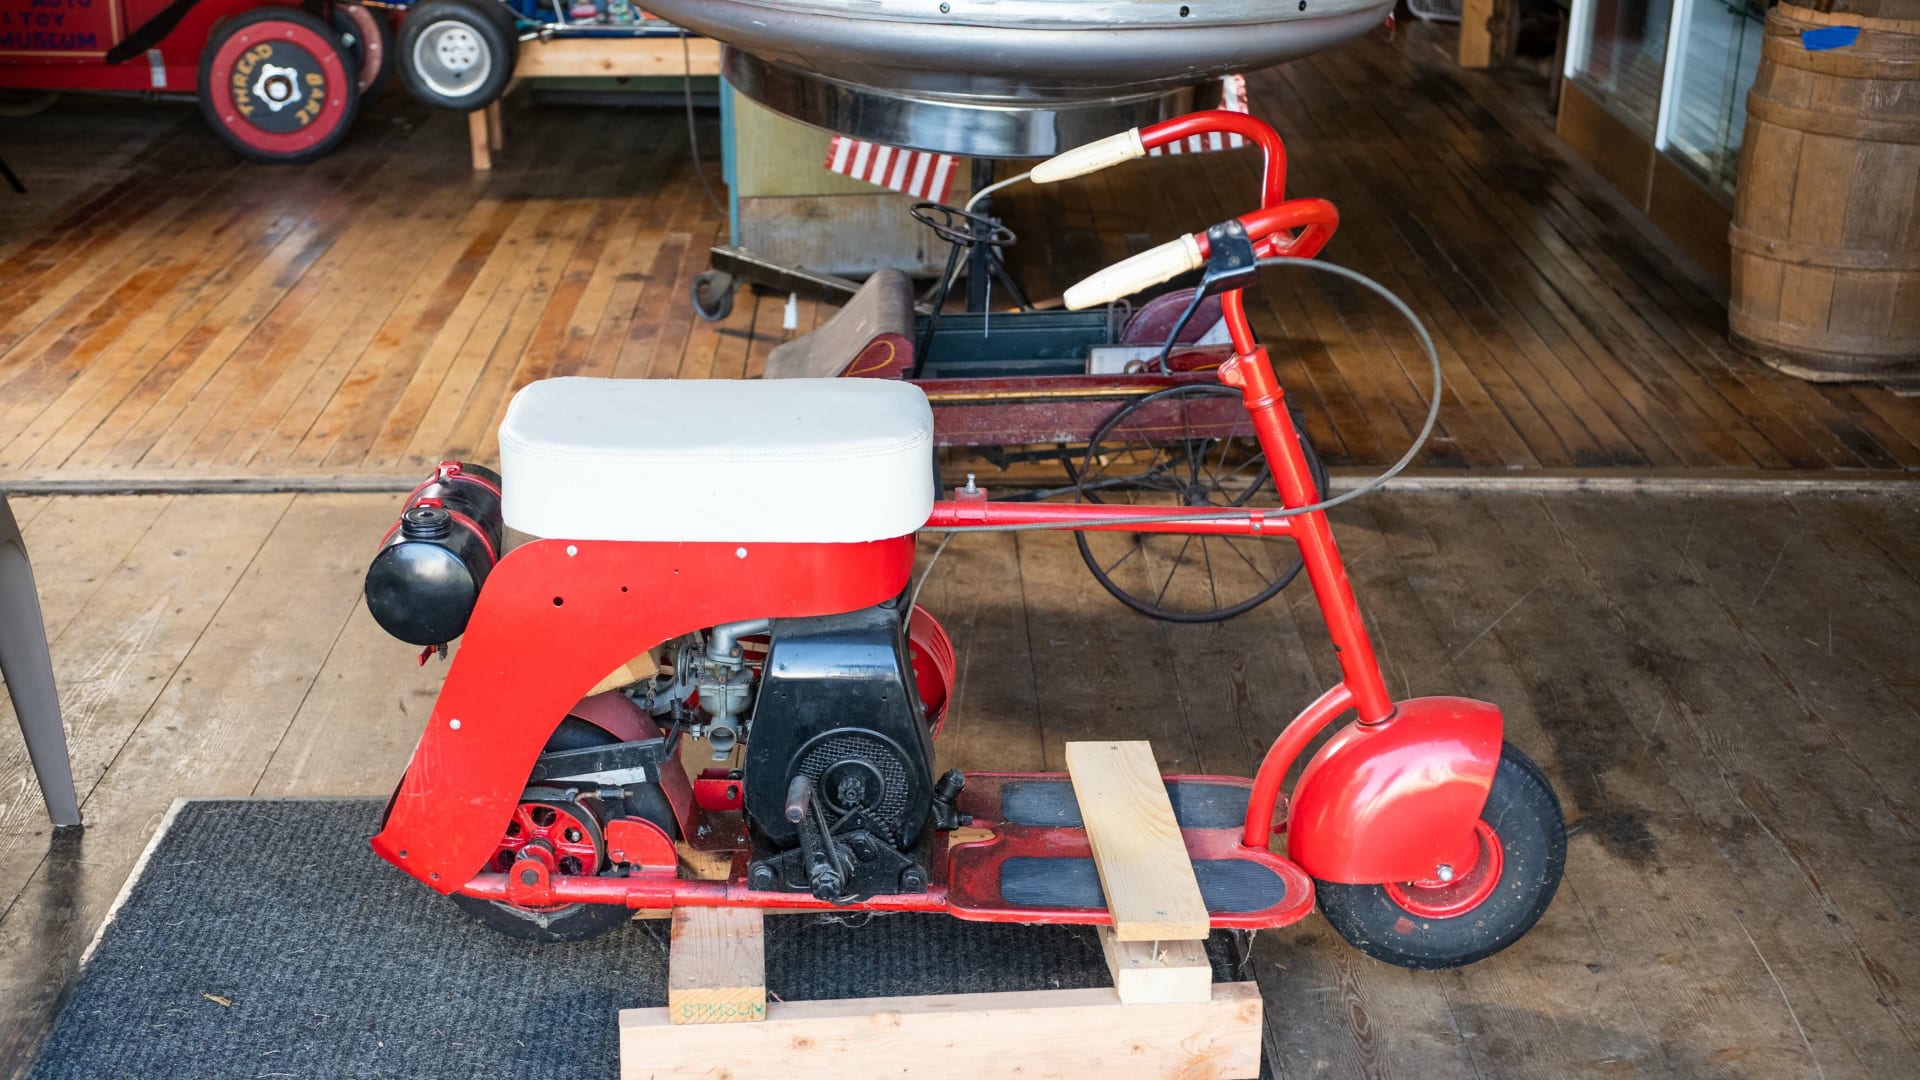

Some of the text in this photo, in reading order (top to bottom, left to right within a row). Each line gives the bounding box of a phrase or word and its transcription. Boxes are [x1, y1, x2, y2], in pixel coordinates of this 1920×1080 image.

[19, 11, 65, 27] TOY
[0, 32, 97, 49] MUSEUM
[232, 44, 273, 117] THREAD
[295, 73, 325, 125] BARE
